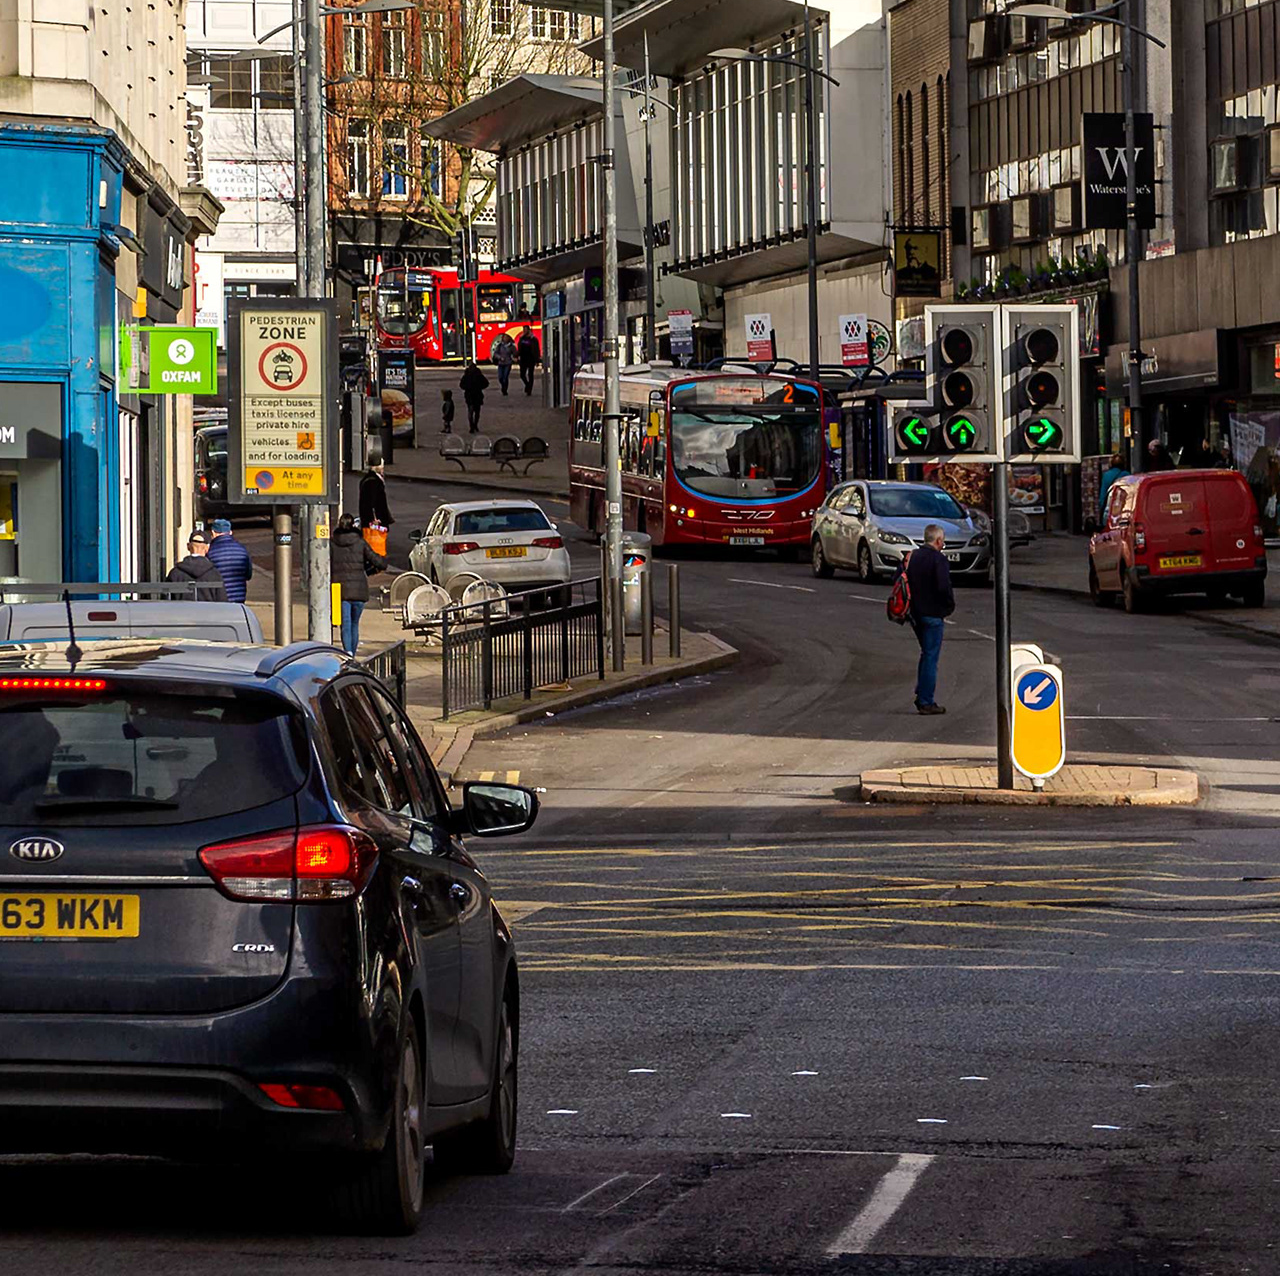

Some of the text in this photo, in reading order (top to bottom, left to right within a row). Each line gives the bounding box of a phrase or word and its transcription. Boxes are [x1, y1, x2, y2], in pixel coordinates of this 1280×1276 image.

[1090, 184, 1151, 195] Waterstne's
[249, 317, 316, 325] PEDESTRIAN
[259, 327, 306, 339] ZONE
[161, 370, 201, 383] OXFAM
[783, 385, 794, 403] 2
[251, 399, 283, 408] Except
[252, 410, 316, 418] taxis licensed
[256, 421, 310, 430] private hire
[252, 438, 290, 446] vehicles
[248, 452, 319, 462] and for loading
[282, 471, 293, 479] At
[288, 481, 308, 489] time
[19, 842, 55, 857] KIA
[57, 898, 124, 930] WKM
[232, 943, 275, 952] CRDi
